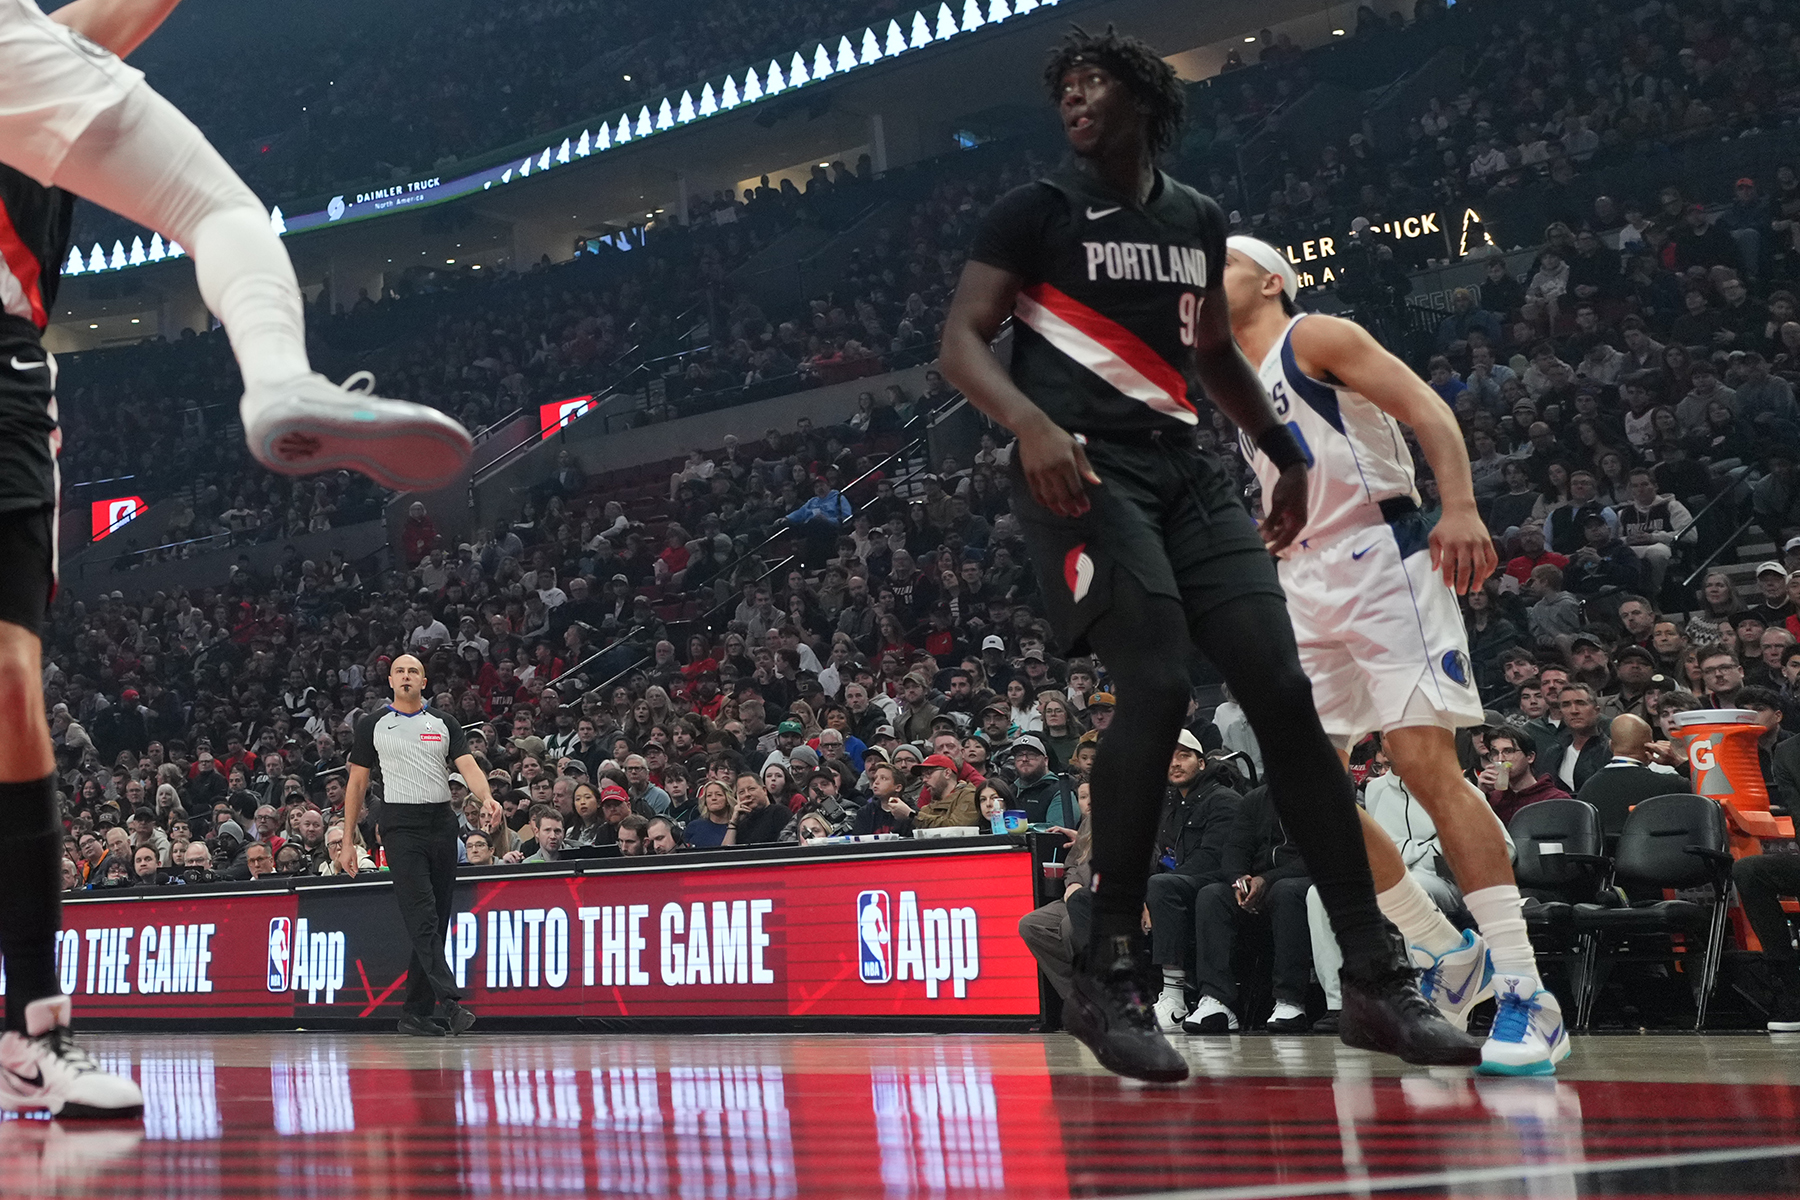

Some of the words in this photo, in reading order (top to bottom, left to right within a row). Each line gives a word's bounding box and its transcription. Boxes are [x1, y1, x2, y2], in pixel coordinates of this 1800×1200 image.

[356, 185, 403, 204] DAIMLER
[407, 177, 440, 192] TRUCK
[1082, 241, 1207, 288] PORTLAND
[1690, 740, 1715, 771] G
[85, 927, 134, 995] THE
[137, 923, 216, 995] GAME
[291, 917, 346, 1005] App
[487, 907, 569, 989] INTO
[578, 903, 649, 988] THE
[660, 898, 774, 988] GAME
[864, 962, 882, 977] NBA
[897, 890, 980, 1000] App
